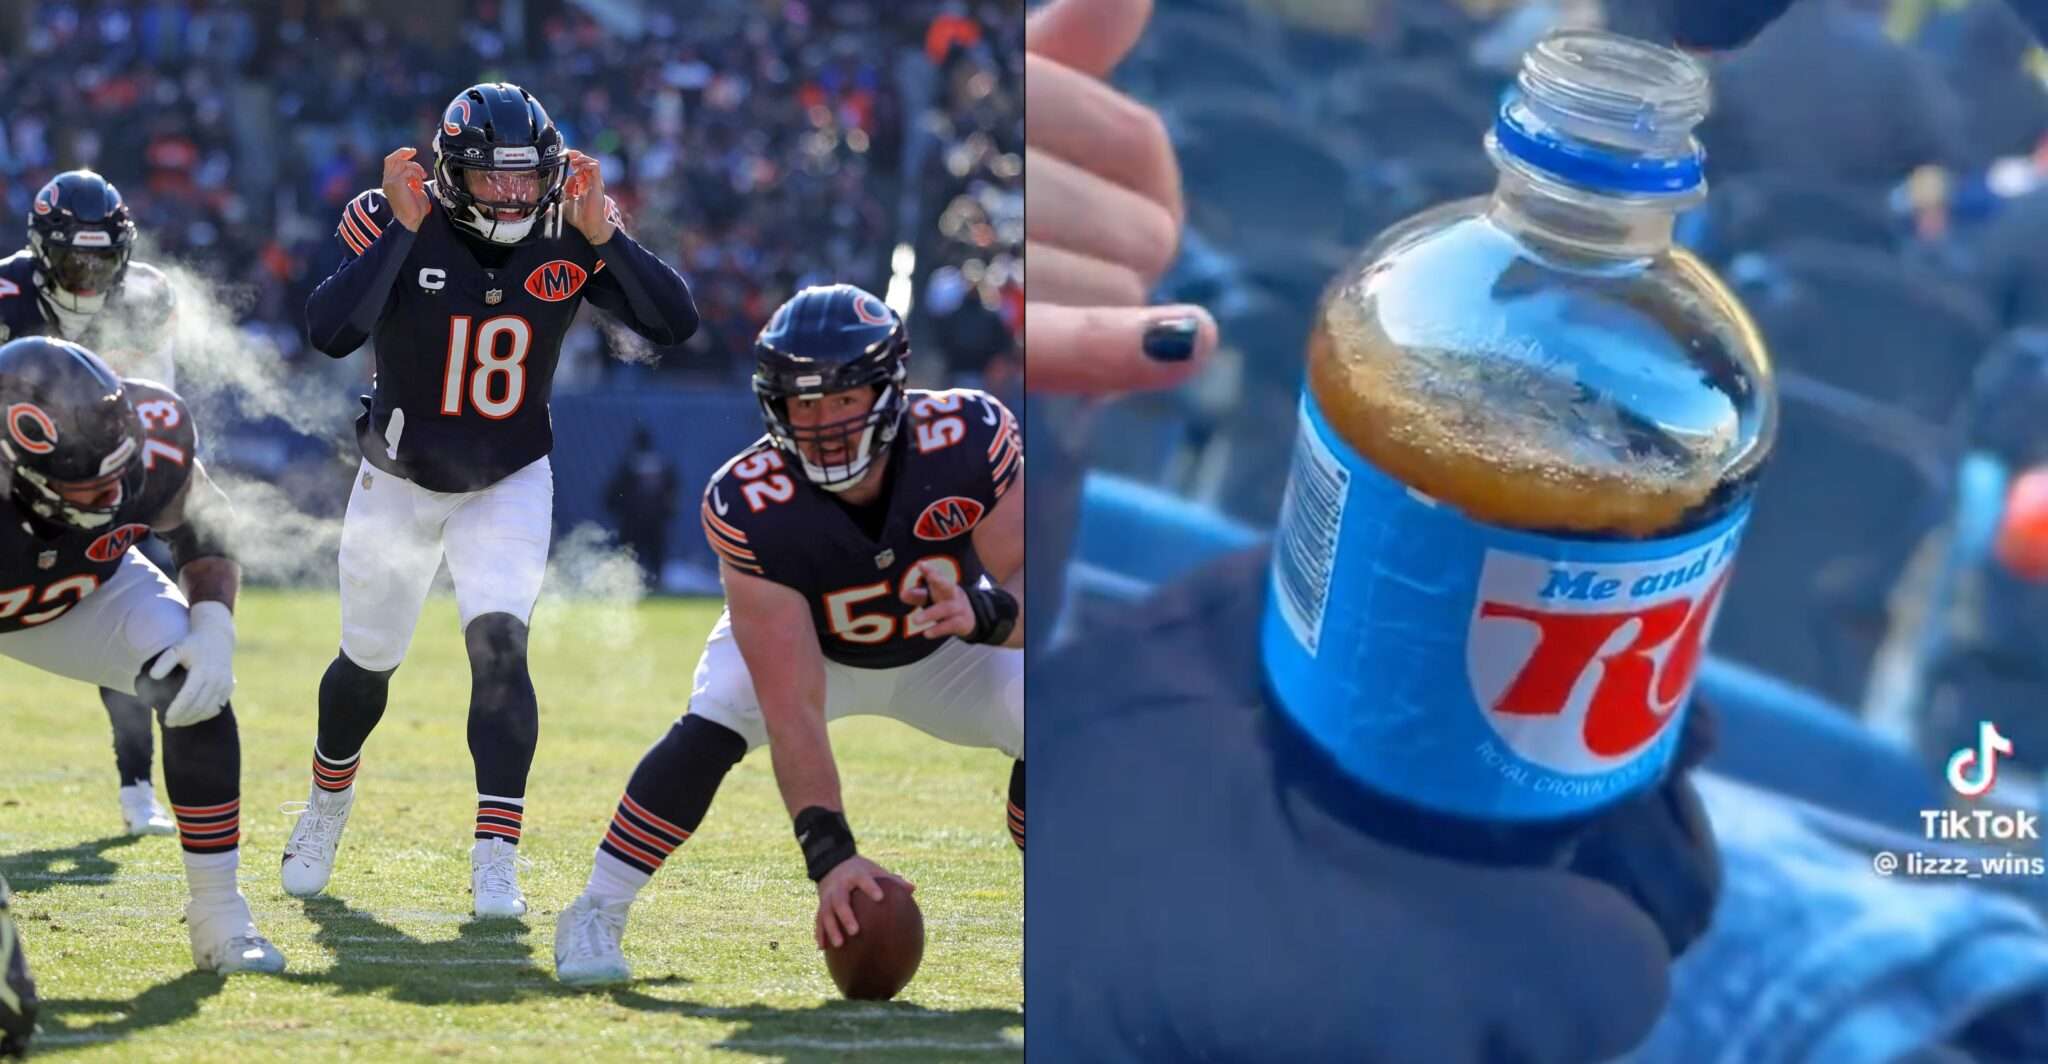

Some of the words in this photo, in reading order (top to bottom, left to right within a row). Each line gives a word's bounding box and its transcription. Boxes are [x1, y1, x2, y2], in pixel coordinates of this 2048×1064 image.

[419, 268, 447, 290] C
[440, 315, 533, 420] 18
[137, 400, 185, 470] 73
[912, 393, 966, 454] 52
[734, 447, 795, 513] 52
[1538, 567, 1621, 600] Me
[1630, 551, 1706, 598] and
[1474, 741, 1530, 785] ROYAL
[1533, 775, 1603, 797] CROWN
